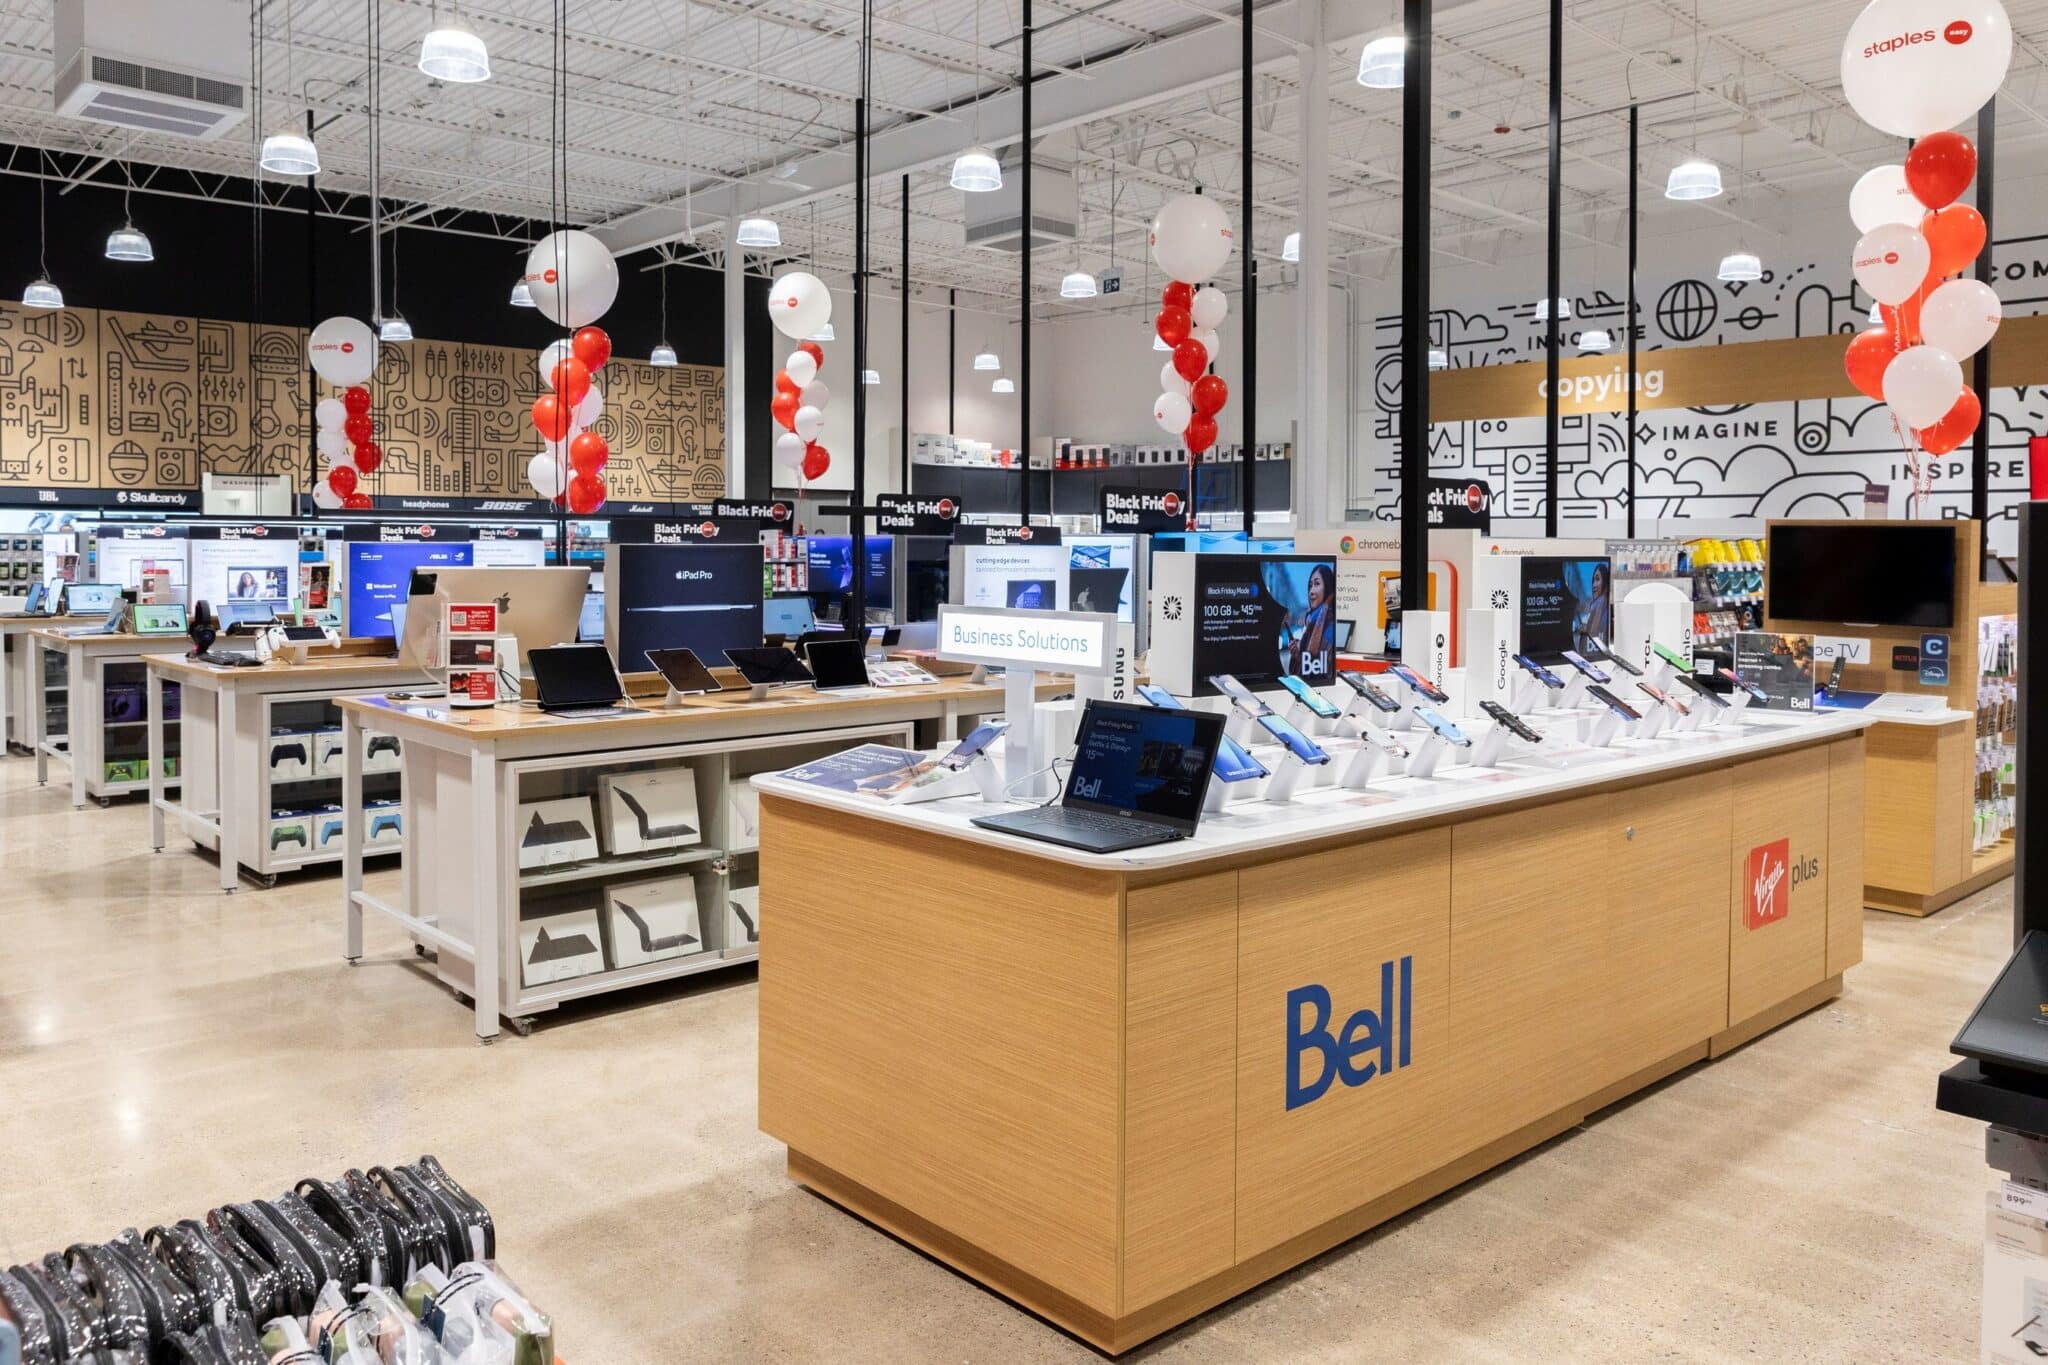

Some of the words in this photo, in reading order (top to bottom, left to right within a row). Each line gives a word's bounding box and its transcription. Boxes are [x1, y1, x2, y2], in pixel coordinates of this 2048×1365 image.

[1863, 29, 1936, 58] staples
[1528, 325, 1646, 350] INNOATE
[1663, 420, 1777, 441] IMAGINE
[1891, 460, 2024, 480] INSPRE
[130, 491, 187, 505] Skullcandy
[402, 499, 450, 510] headphones
[474, 501, 533, 511] BOSE
[1106, 493, 1141, 510] Black
[1142, 493, 1186, 516] Fridy
[1445, 487, 1488, 511] Fridy
[717, 504, 750, 517] Black
[751, 504, 793, 521] Fridy
[917, 500, 960, 518] Fridy
[1106, 508, 1140, 525] Deals
[1427, 506, 1444, 523] als
[881, 514, 914, 527] Deals
[380, 526, 404, 535] Black
[405, 525, 436, 537] Fridy
[380, 534, 404, 542] Deals
[654, 523, 682, 534] Black
[683, 523, 720, 536] Fridy
[654, 533, 682, 543] Deals
[986, 527, 1007, 537] Black
[1007, 527, 1033, 540] Fridy
[986, 536, 1006, 545] Deals
[1358, 539, 1401, 550] chromeb
[682, 570, 700, 580] iPad
[700, 571, 712, 580] Pro
[1204, 604, 1219, 616] 100
[1220, 604, 1232, 616] GB
[954, 625, 1013, 647] Business
[1017, 629, 1088, 653] Solutions
[1837, 643, 1861, 658] TV
[1301, 651, 1328, 676] Bell
[1498, 639, 1507, 690] Google
[1113, 647, 1125, 700] SUNG
[1790, 697, 1810, 709] Bell
[1073, 775, 1102, 799] Bell
[1754, 851, 1785, 917] Virgin
[1791, 854, 1818, 892] plus
[1285, 955, 1413, 1112] Bell
